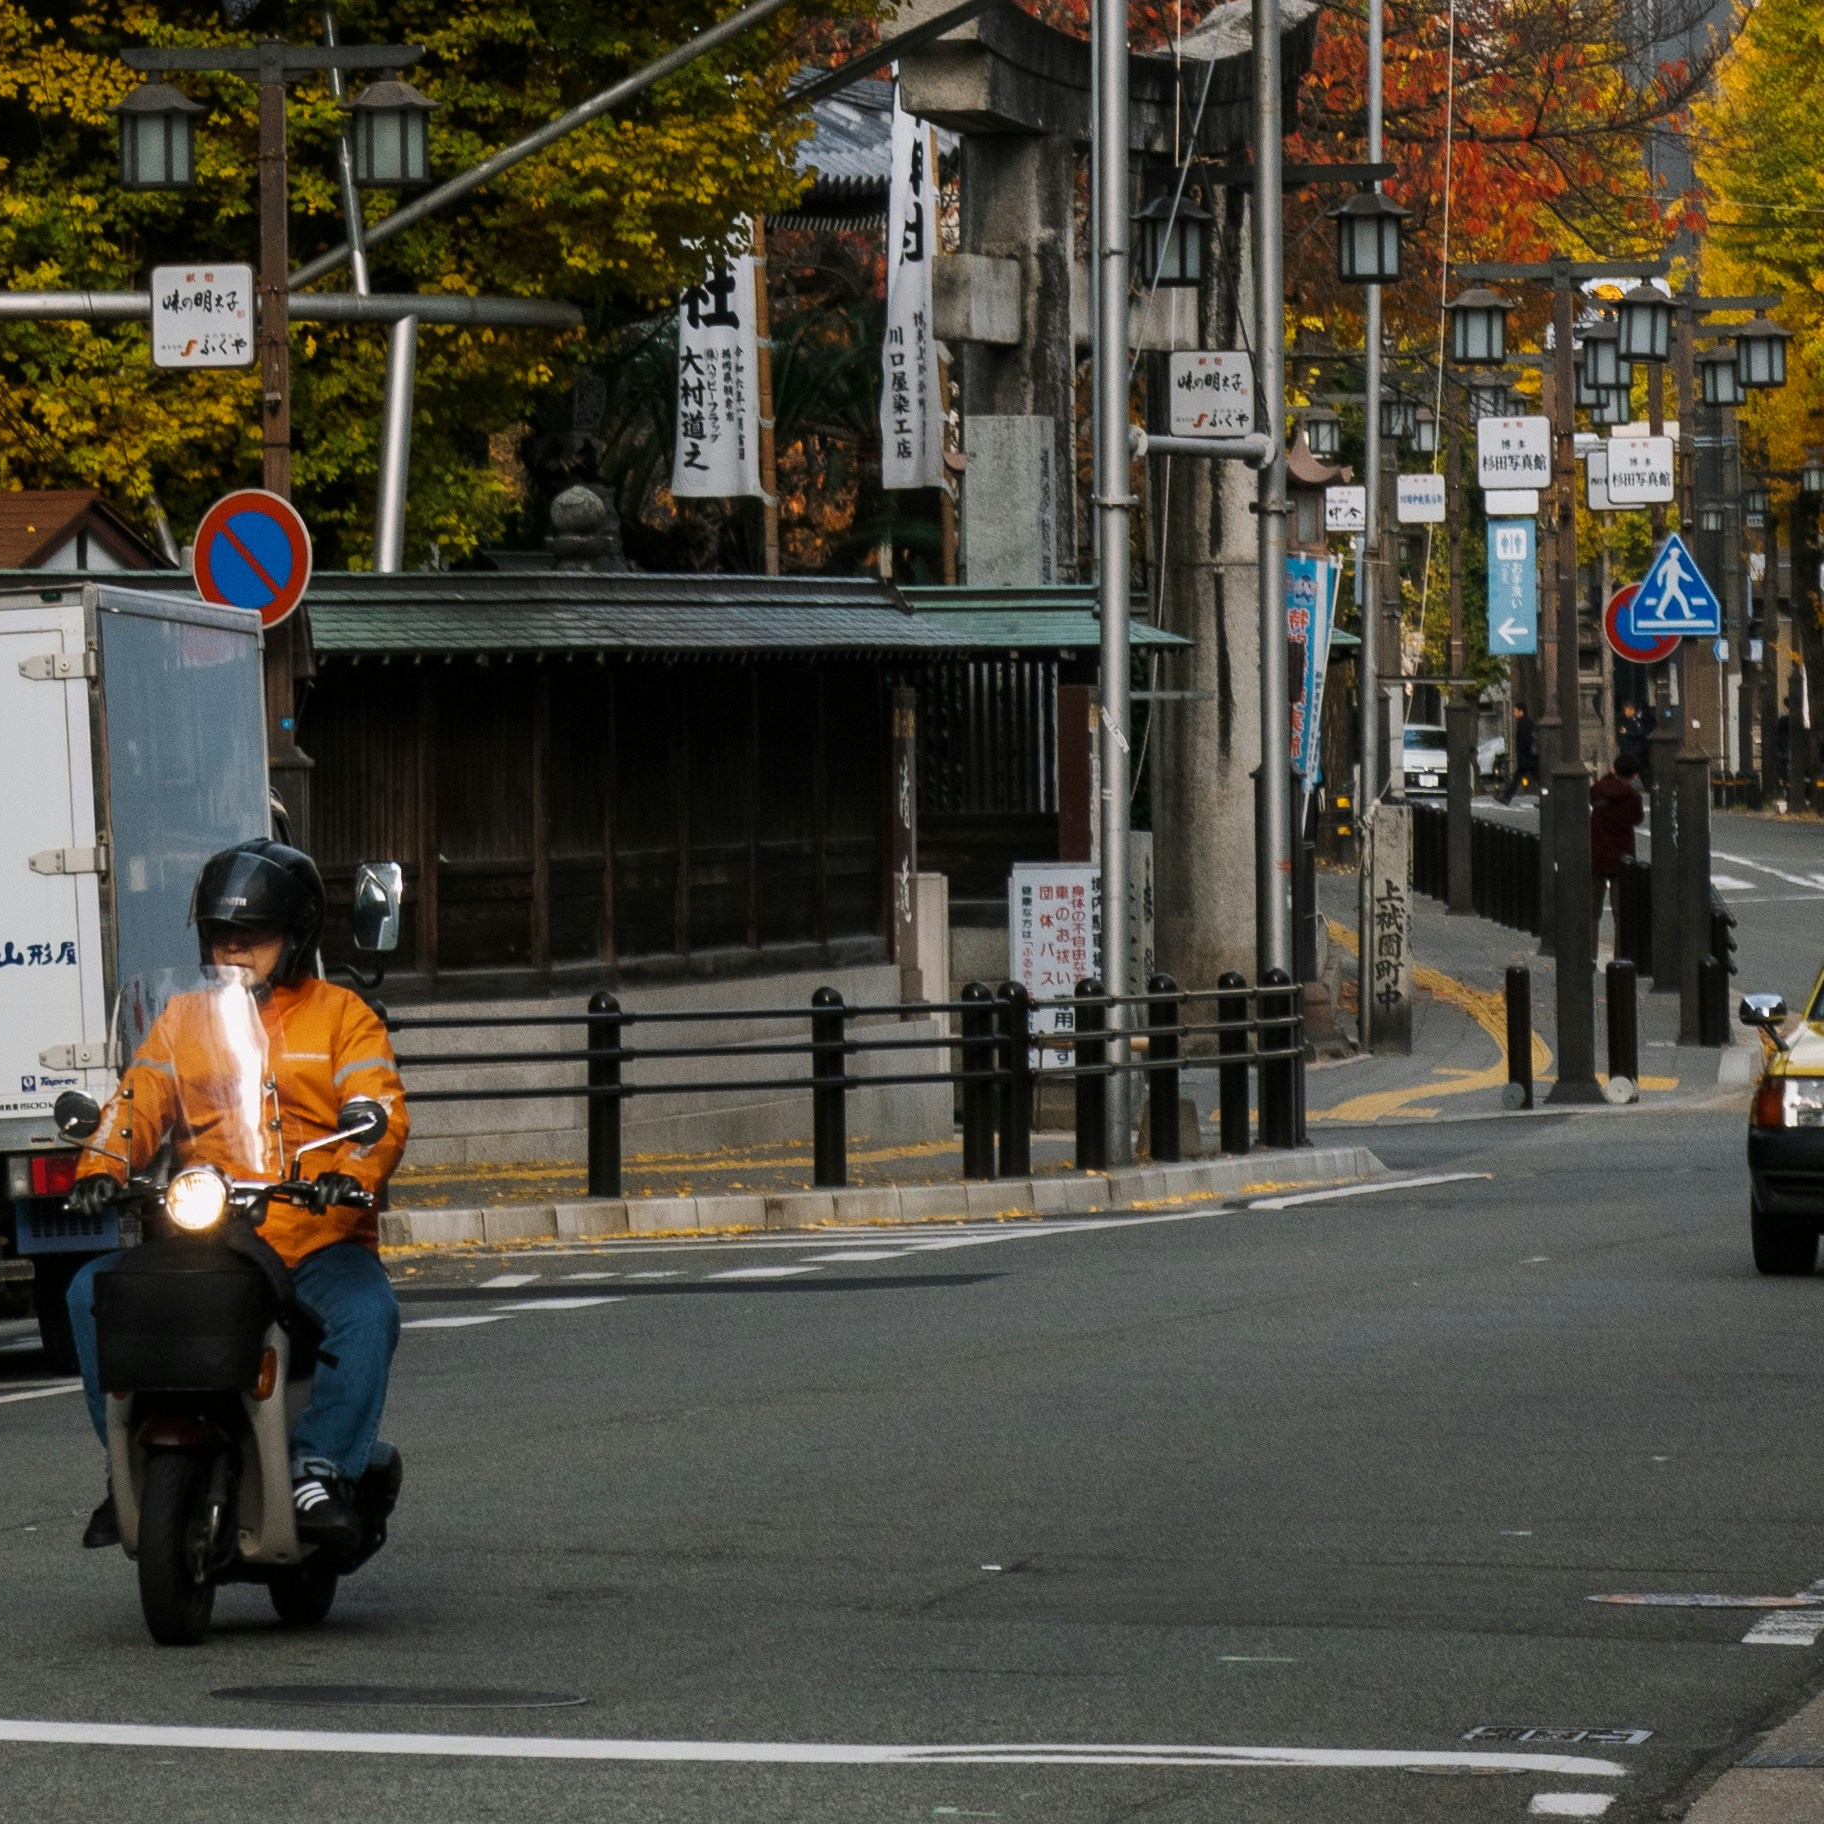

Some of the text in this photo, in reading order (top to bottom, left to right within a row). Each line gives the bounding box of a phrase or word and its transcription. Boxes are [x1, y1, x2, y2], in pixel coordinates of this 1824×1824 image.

[162, 289, 239, 314] 味の明太子
[200, 338, 247, 356] ふくや
[888, 325, 913, 459] 川口屋染工店
[1177, 370, 1243, 392] 味の明太子
[680, 345, 711, 472] 大村道之
[1209, 412, 1250, 428] ふくや
[1482, 453, 1547, 472] 杉田写真館
[1612, 471, 1672, 488] 杉田写真館
[1039, 885, 1055, 986] 団体バス
